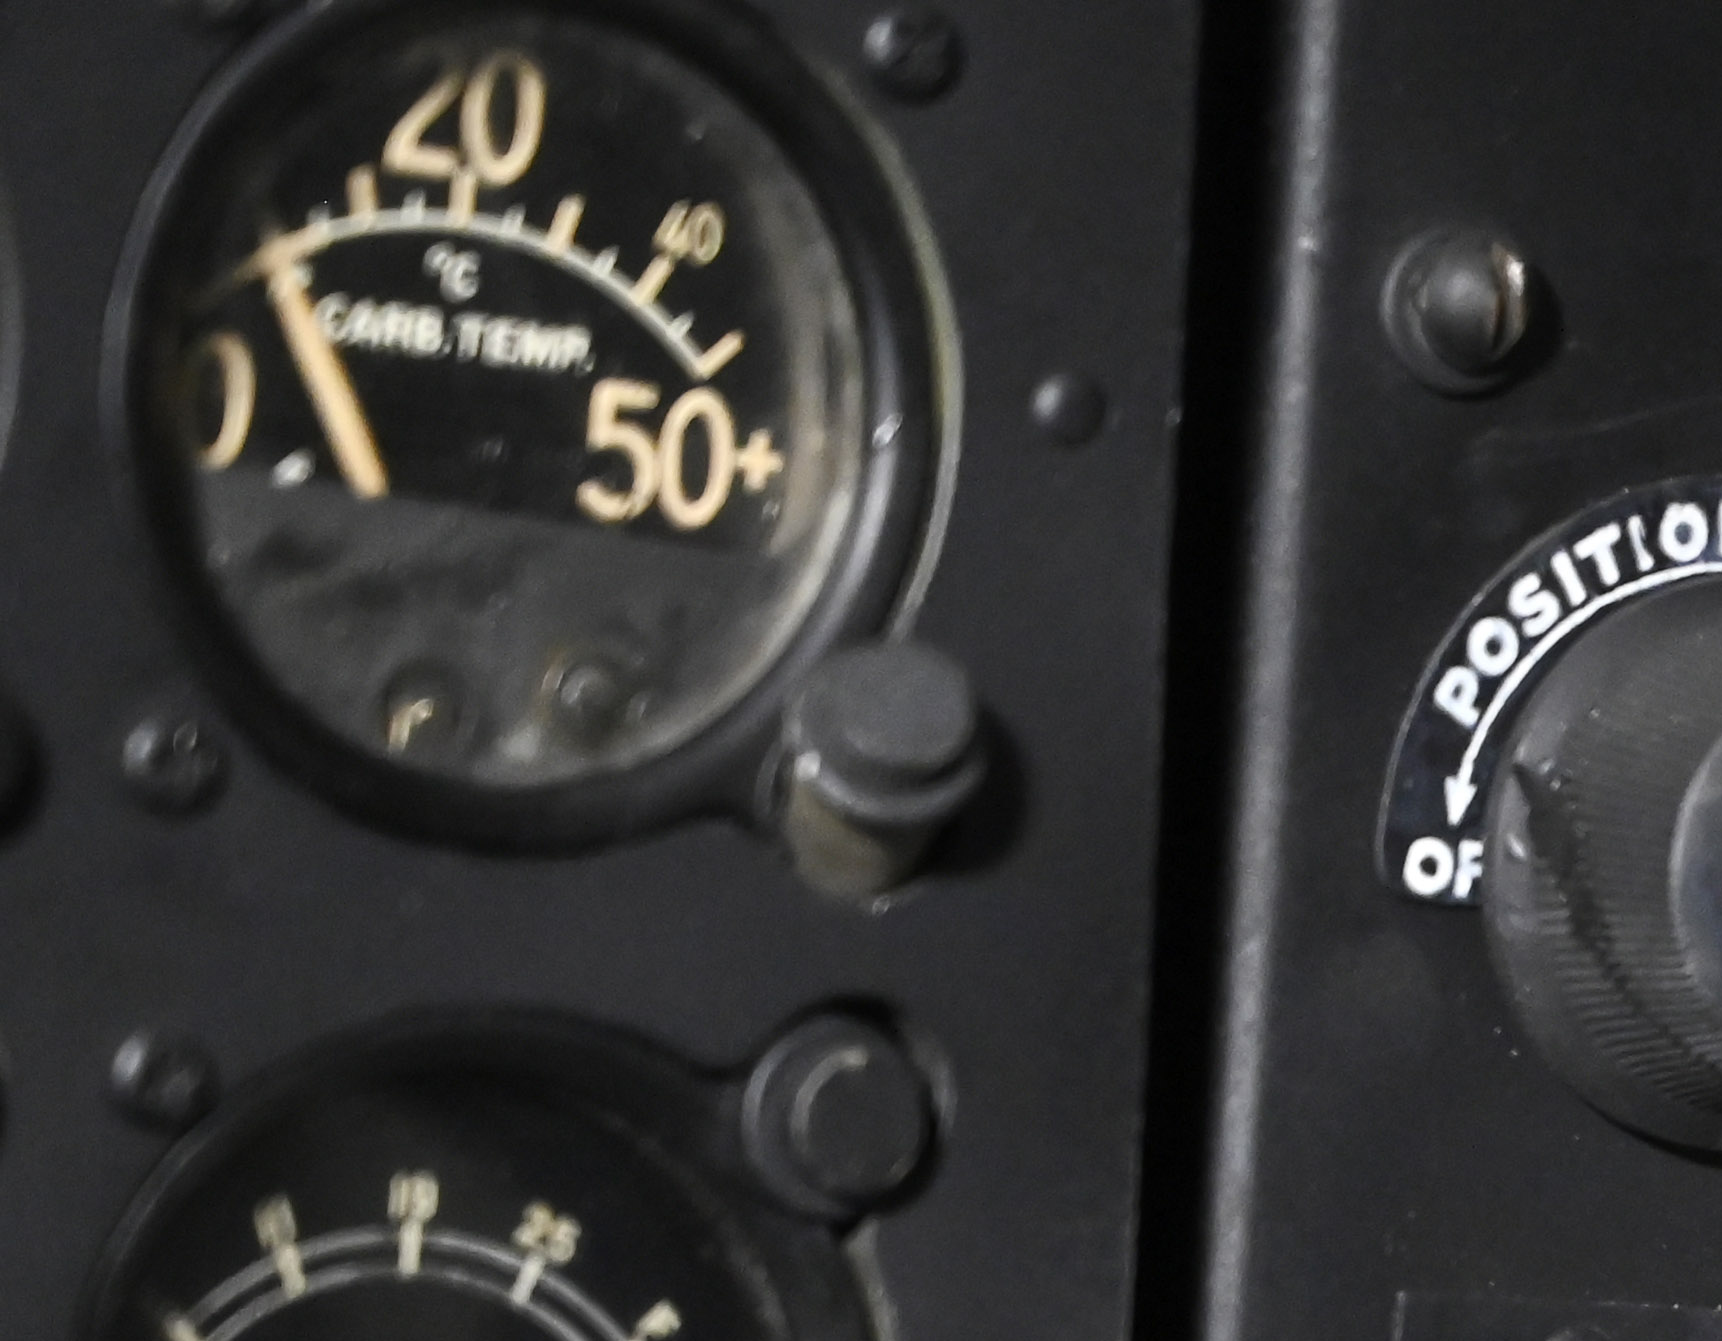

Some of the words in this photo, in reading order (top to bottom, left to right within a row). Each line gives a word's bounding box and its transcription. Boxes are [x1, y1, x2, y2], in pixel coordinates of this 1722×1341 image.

[383, 50, 546, 187] 20
[655, 200, 727, 265] 40
[1403, 836, 1484, 899] OF
